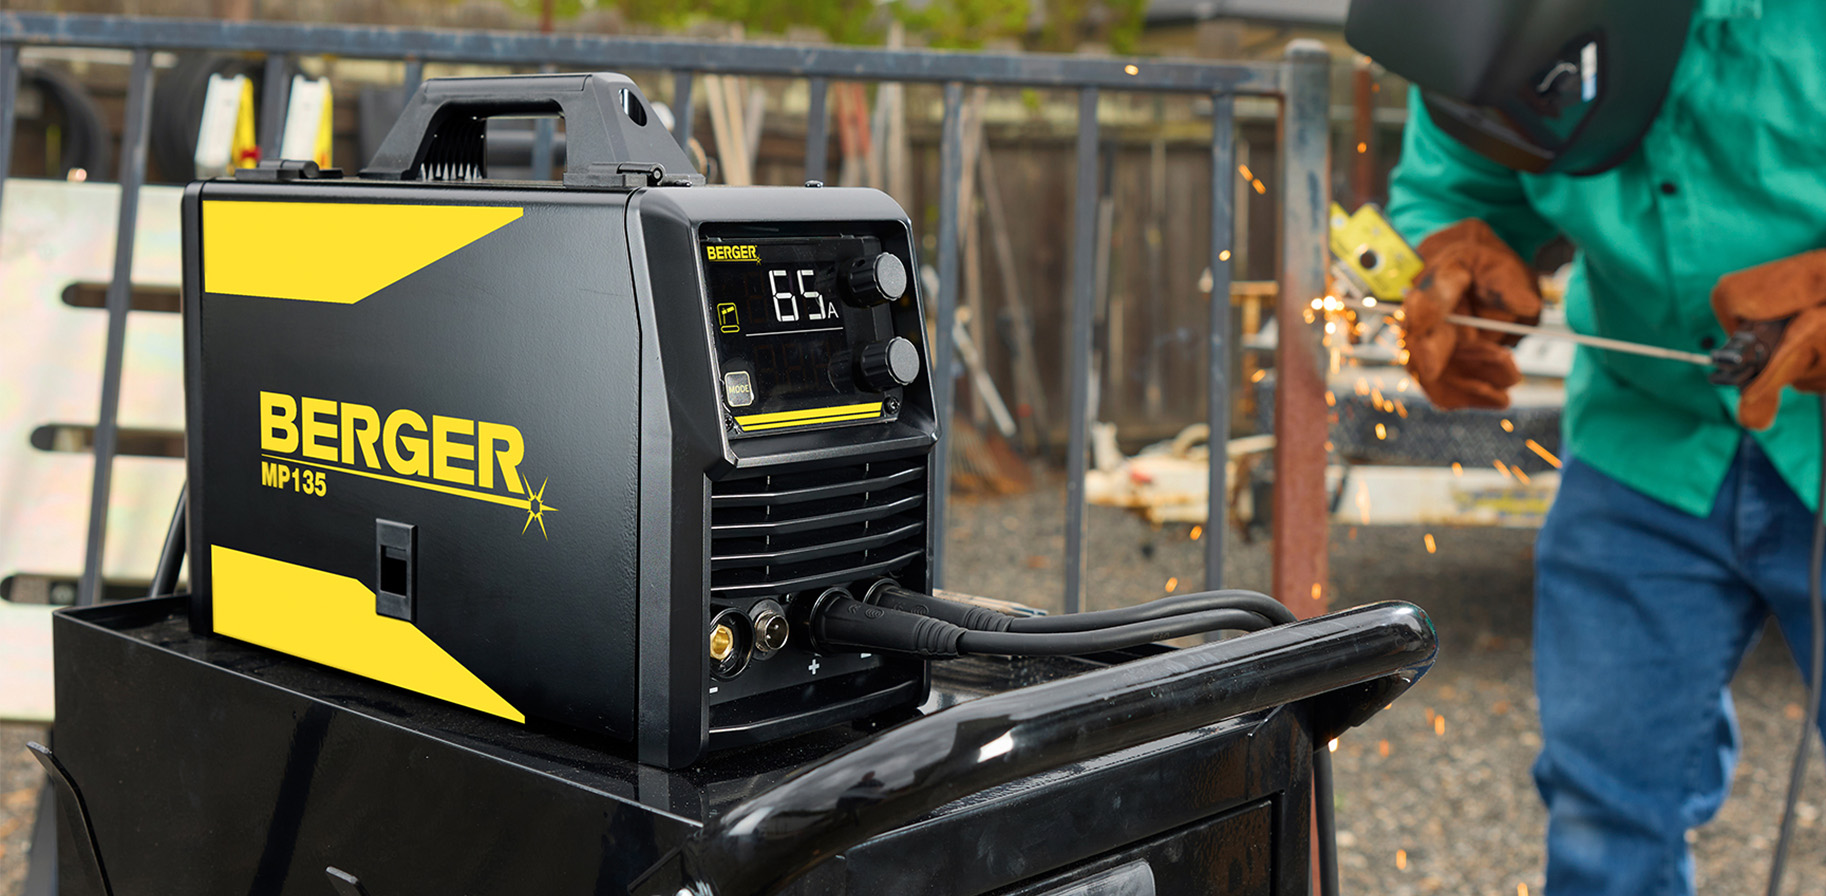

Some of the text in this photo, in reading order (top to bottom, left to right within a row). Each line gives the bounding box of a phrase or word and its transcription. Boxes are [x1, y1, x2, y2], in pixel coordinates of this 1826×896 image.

[706, 244, 757, 260] BERGER
[728, 384, 750, 394] MODE
[260, 390, 526, 495] BERGER
[261, 461, 327, 497] MP135
